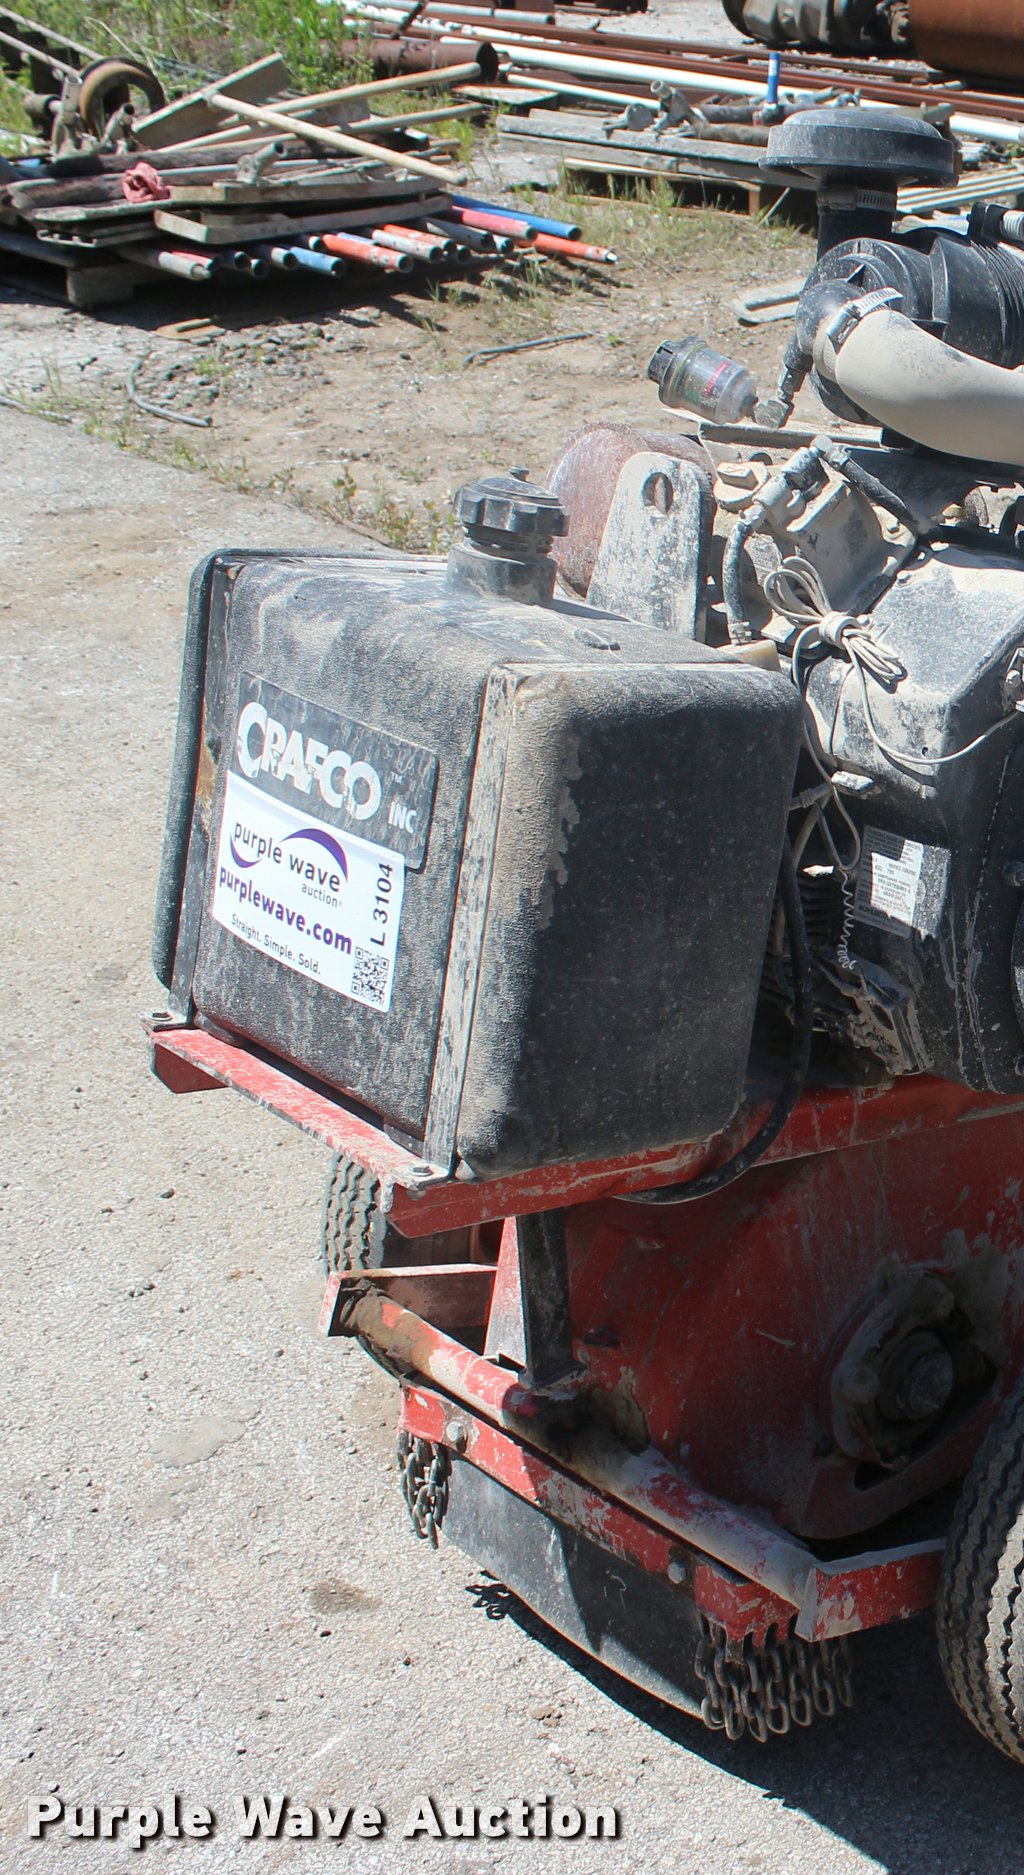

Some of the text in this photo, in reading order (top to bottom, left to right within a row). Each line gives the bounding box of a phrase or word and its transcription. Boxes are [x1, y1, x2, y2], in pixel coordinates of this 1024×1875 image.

[237, 702, 382, 820] CRAFCO
[388, 801, 417, 833] INC
[234, 822, 341, 893] purple wave
[219, 866, 352, 955] purplewave.com
[231, 913, 321, 975] Straight. Simple. Sold.
